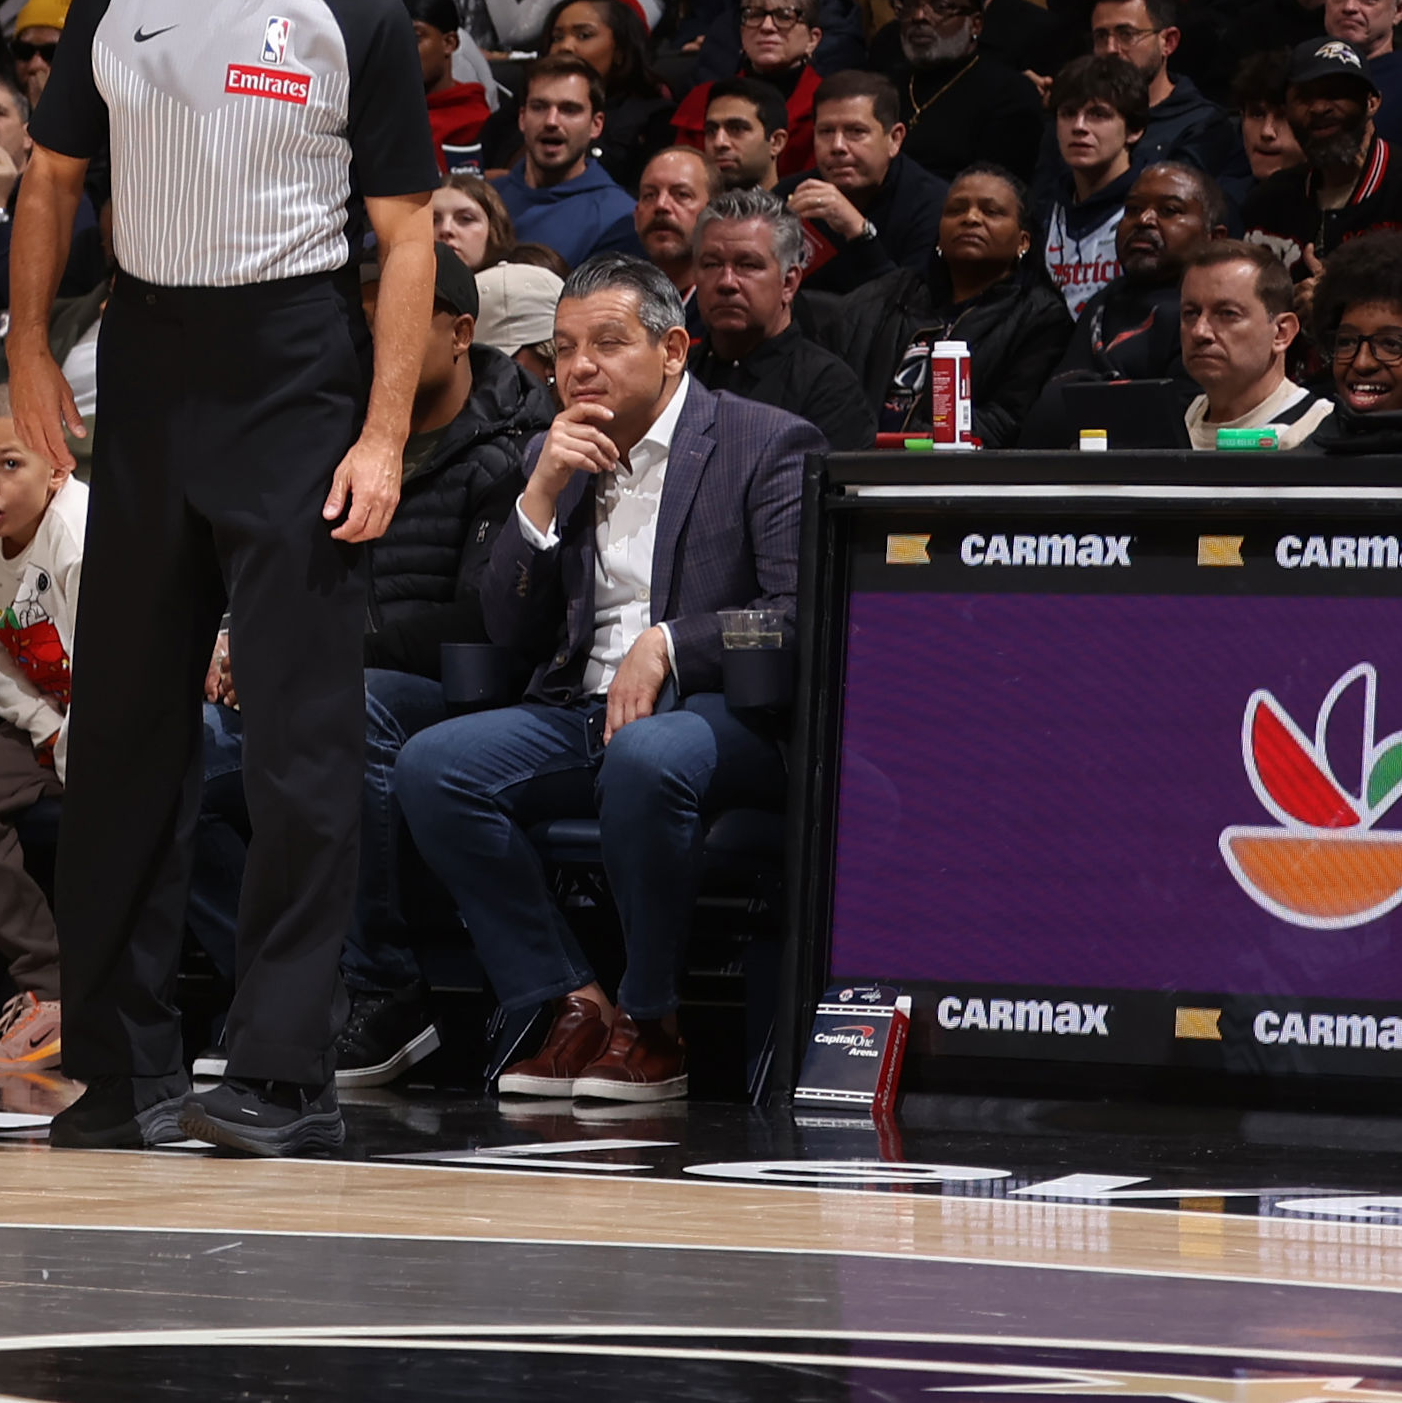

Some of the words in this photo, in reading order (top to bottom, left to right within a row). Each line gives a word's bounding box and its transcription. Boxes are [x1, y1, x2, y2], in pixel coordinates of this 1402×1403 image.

[228, 69, 308, 98] Emirates
[1276, 535, 1402, 568] CARm
[848, 1048, 879, 1058] Arena
